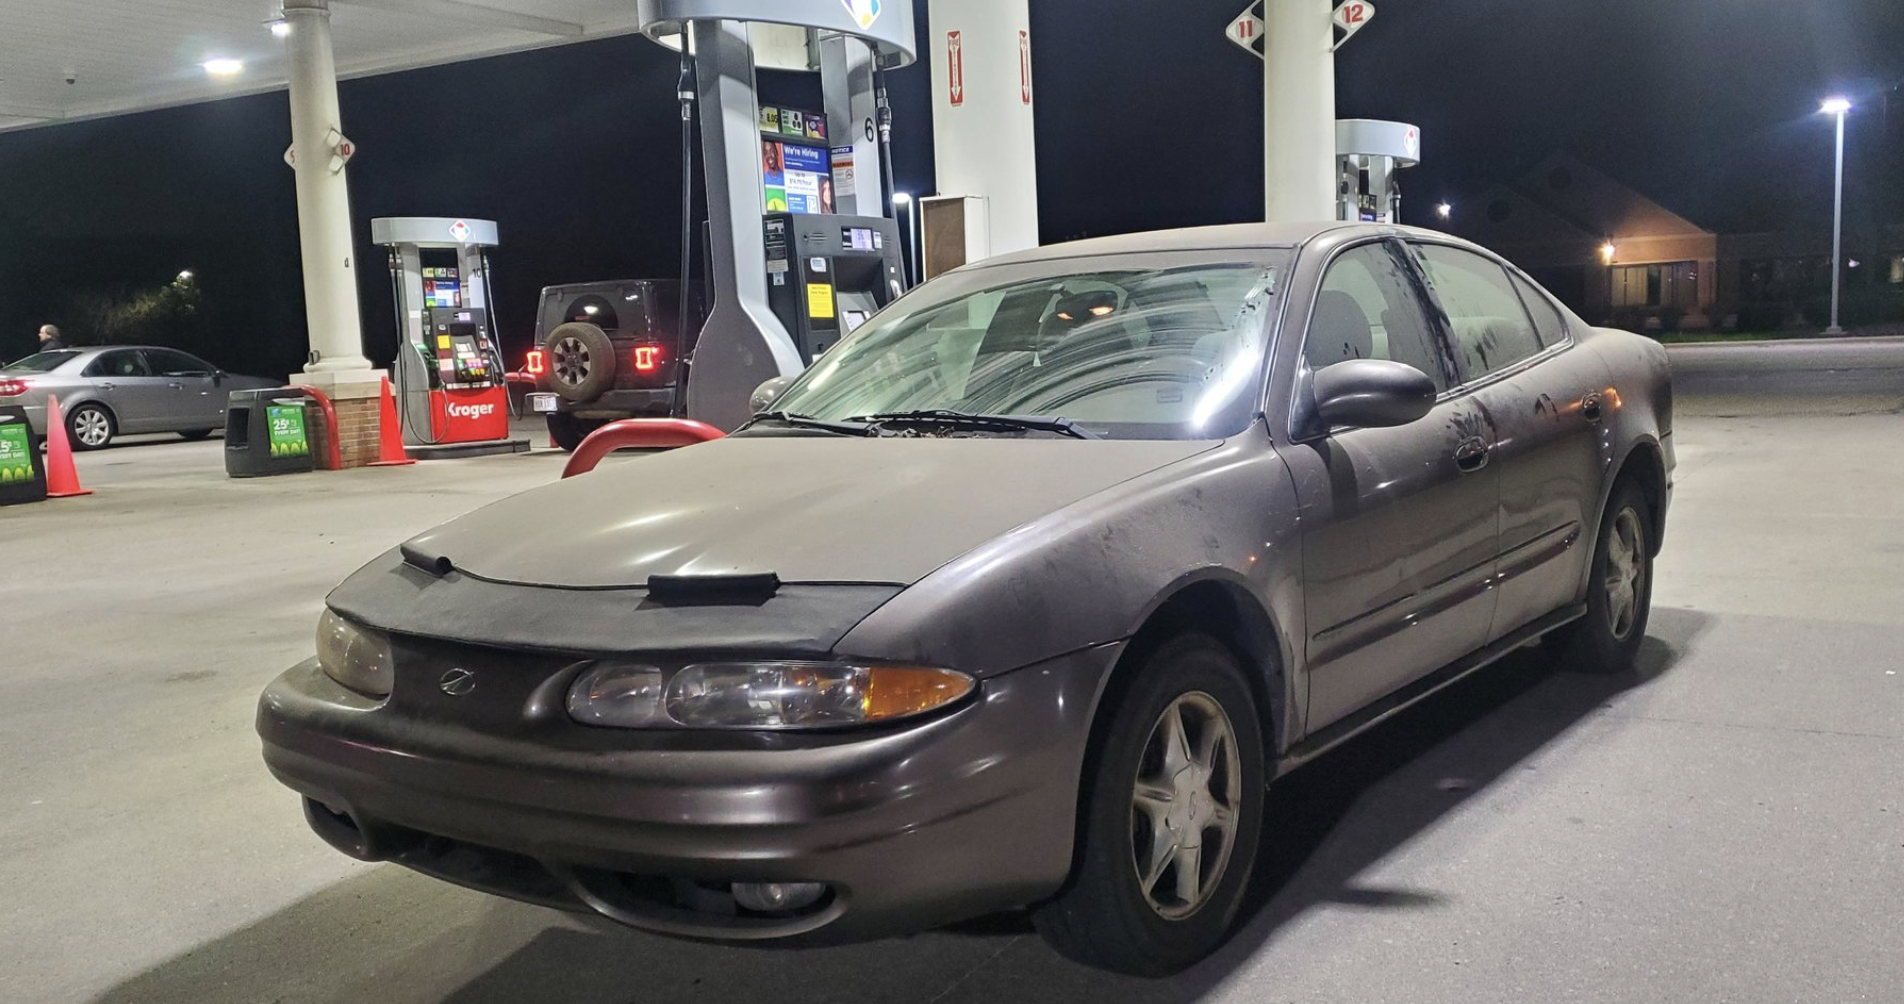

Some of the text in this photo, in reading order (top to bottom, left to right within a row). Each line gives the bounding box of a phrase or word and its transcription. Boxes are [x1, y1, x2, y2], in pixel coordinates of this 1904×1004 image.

[1343, 4, 1363, 24] 12
[1238, 20, 1253, 38] 11
[865, 117, 874, 142] 6
[340, 143, 350, 156] 10
[784, 146, 819, 159] We're Hiring
[472, 267, 482, 278] 10
[448, 402, 494, 419] Kroger
